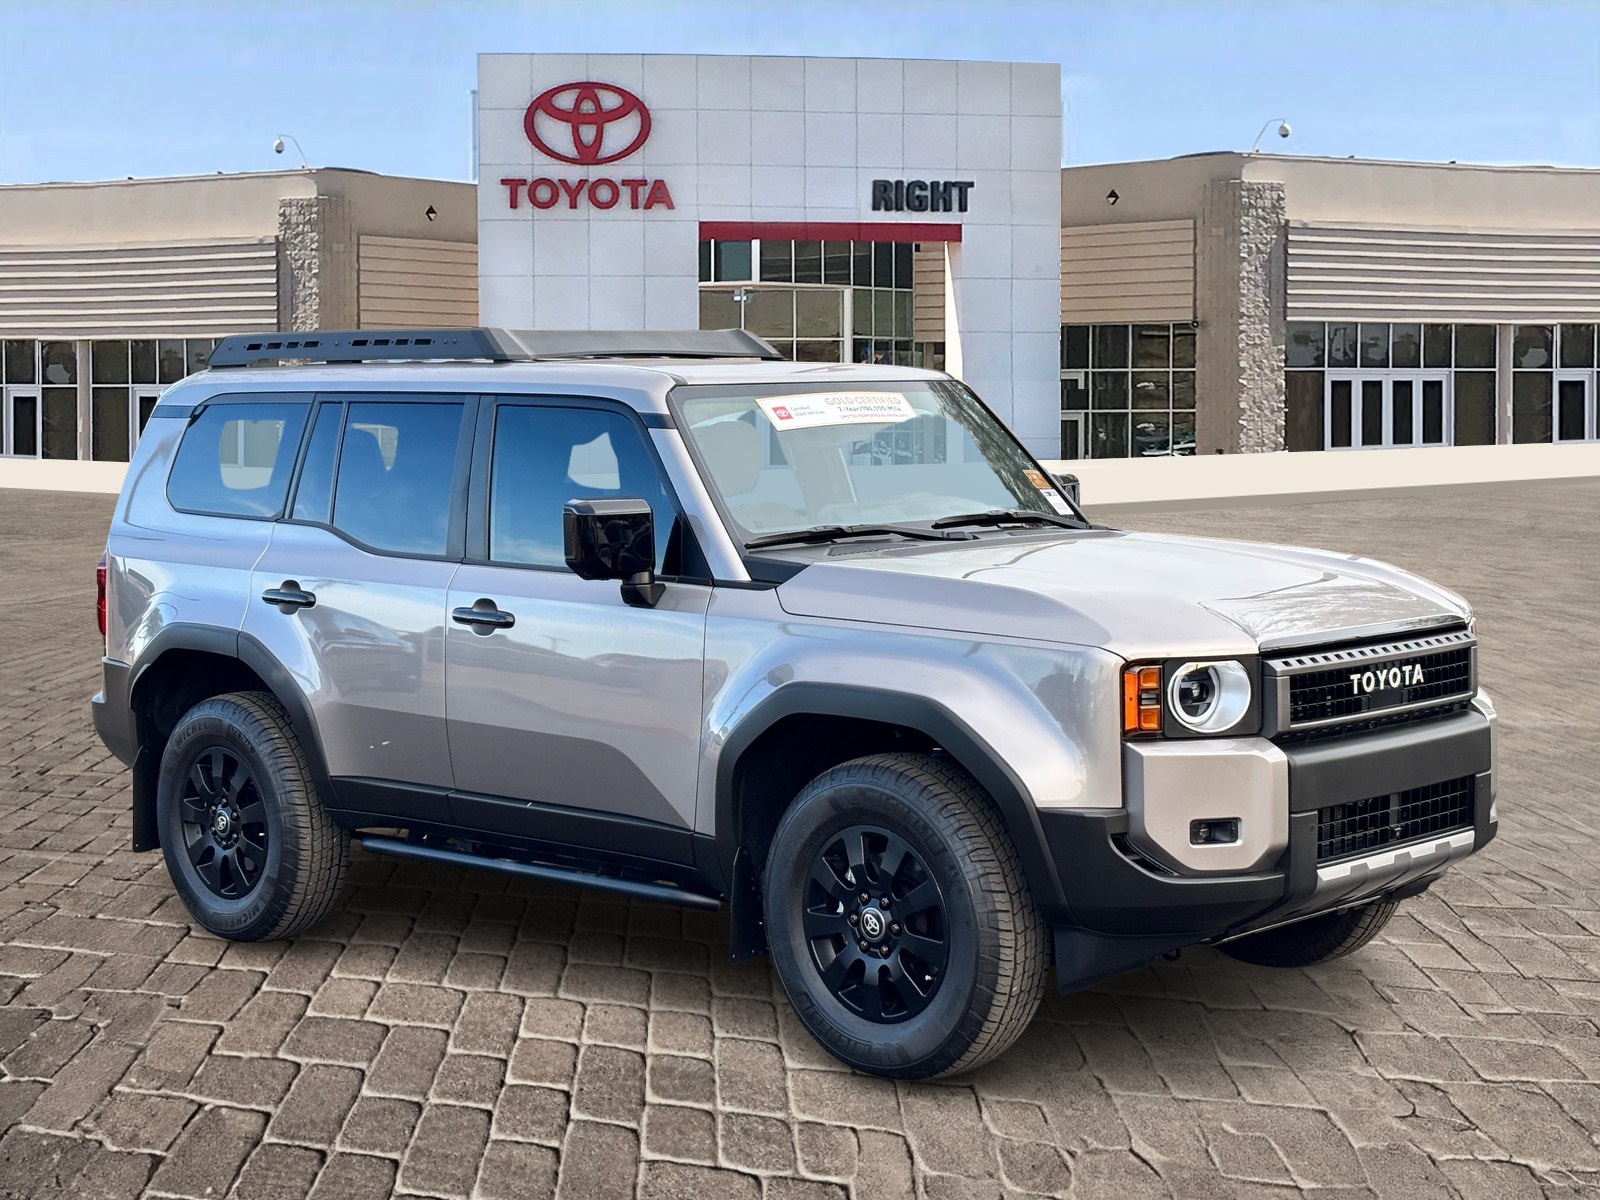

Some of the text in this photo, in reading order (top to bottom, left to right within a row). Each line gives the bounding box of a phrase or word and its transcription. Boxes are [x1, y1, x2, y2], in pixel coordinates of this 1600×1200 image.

[501, 178, 675, 210] TOYOTA
[872, 179, 975, 213] RIGHT
[824, 396, 902, 406] GOLD CERTIFIED
[1350, 663, 1425, 695] TOYOTA
